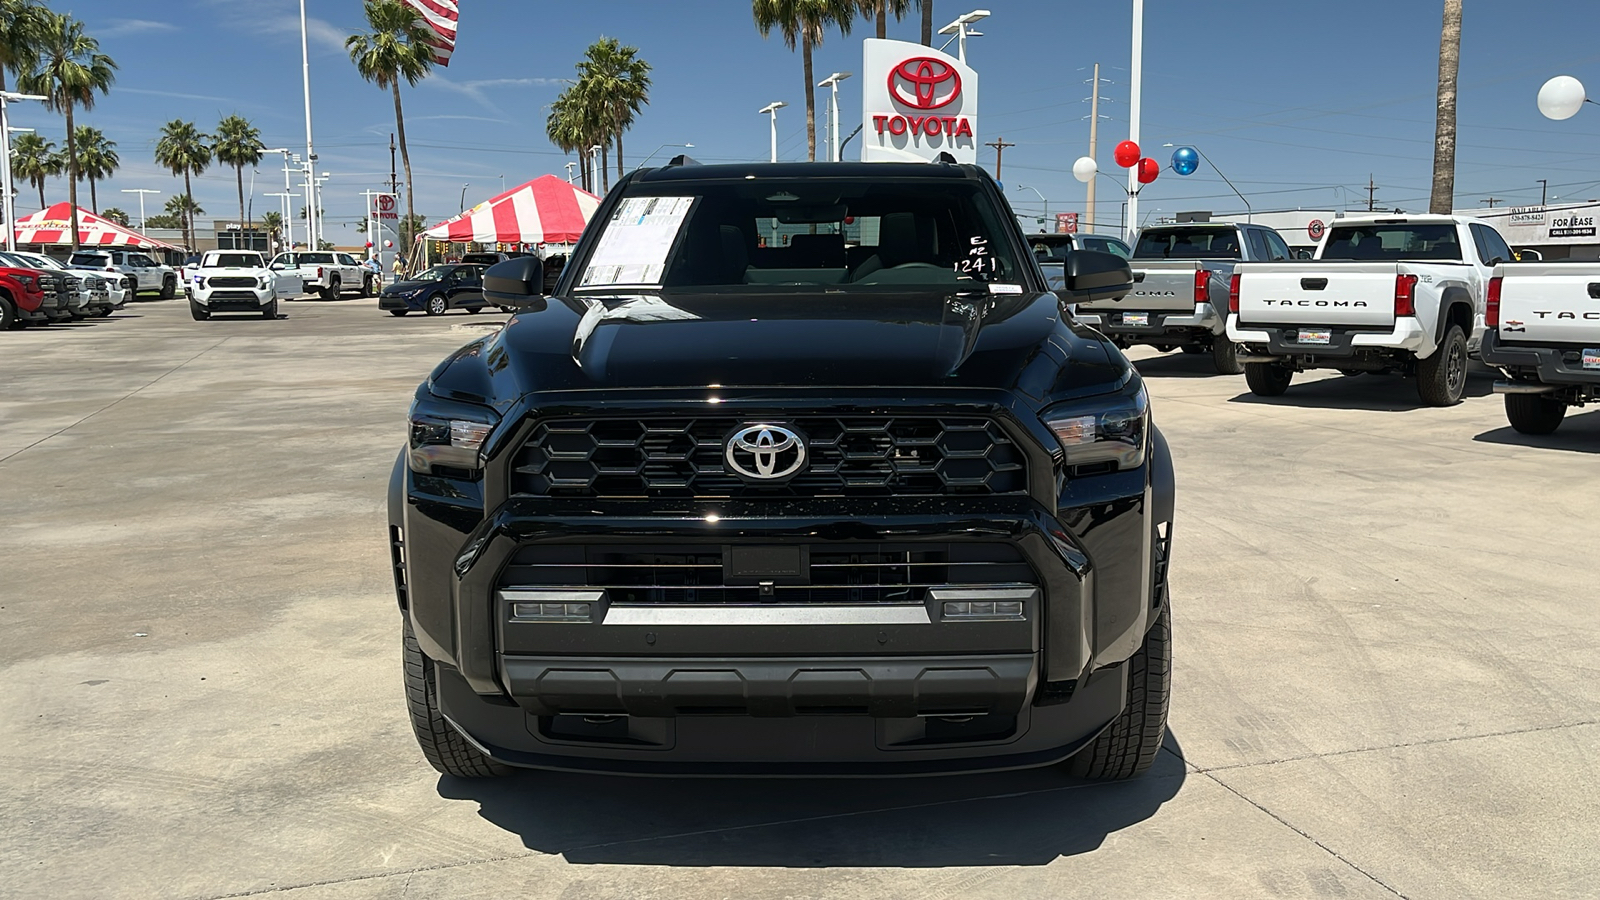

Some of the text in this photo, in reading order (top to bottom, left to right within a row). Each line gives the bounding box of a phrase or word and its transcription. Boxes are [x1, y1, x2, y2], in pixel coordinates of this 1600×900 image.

[873, 116, 973, 137] TOYOTA
[1552, 218, 1569, 227] FOR
[1570, 217, 1593, 226] LEASE
[970, 236, 988, 245] E
[953, 257, 996, 273] 1241
[1263, 299, 1368, 307] TACOMA
